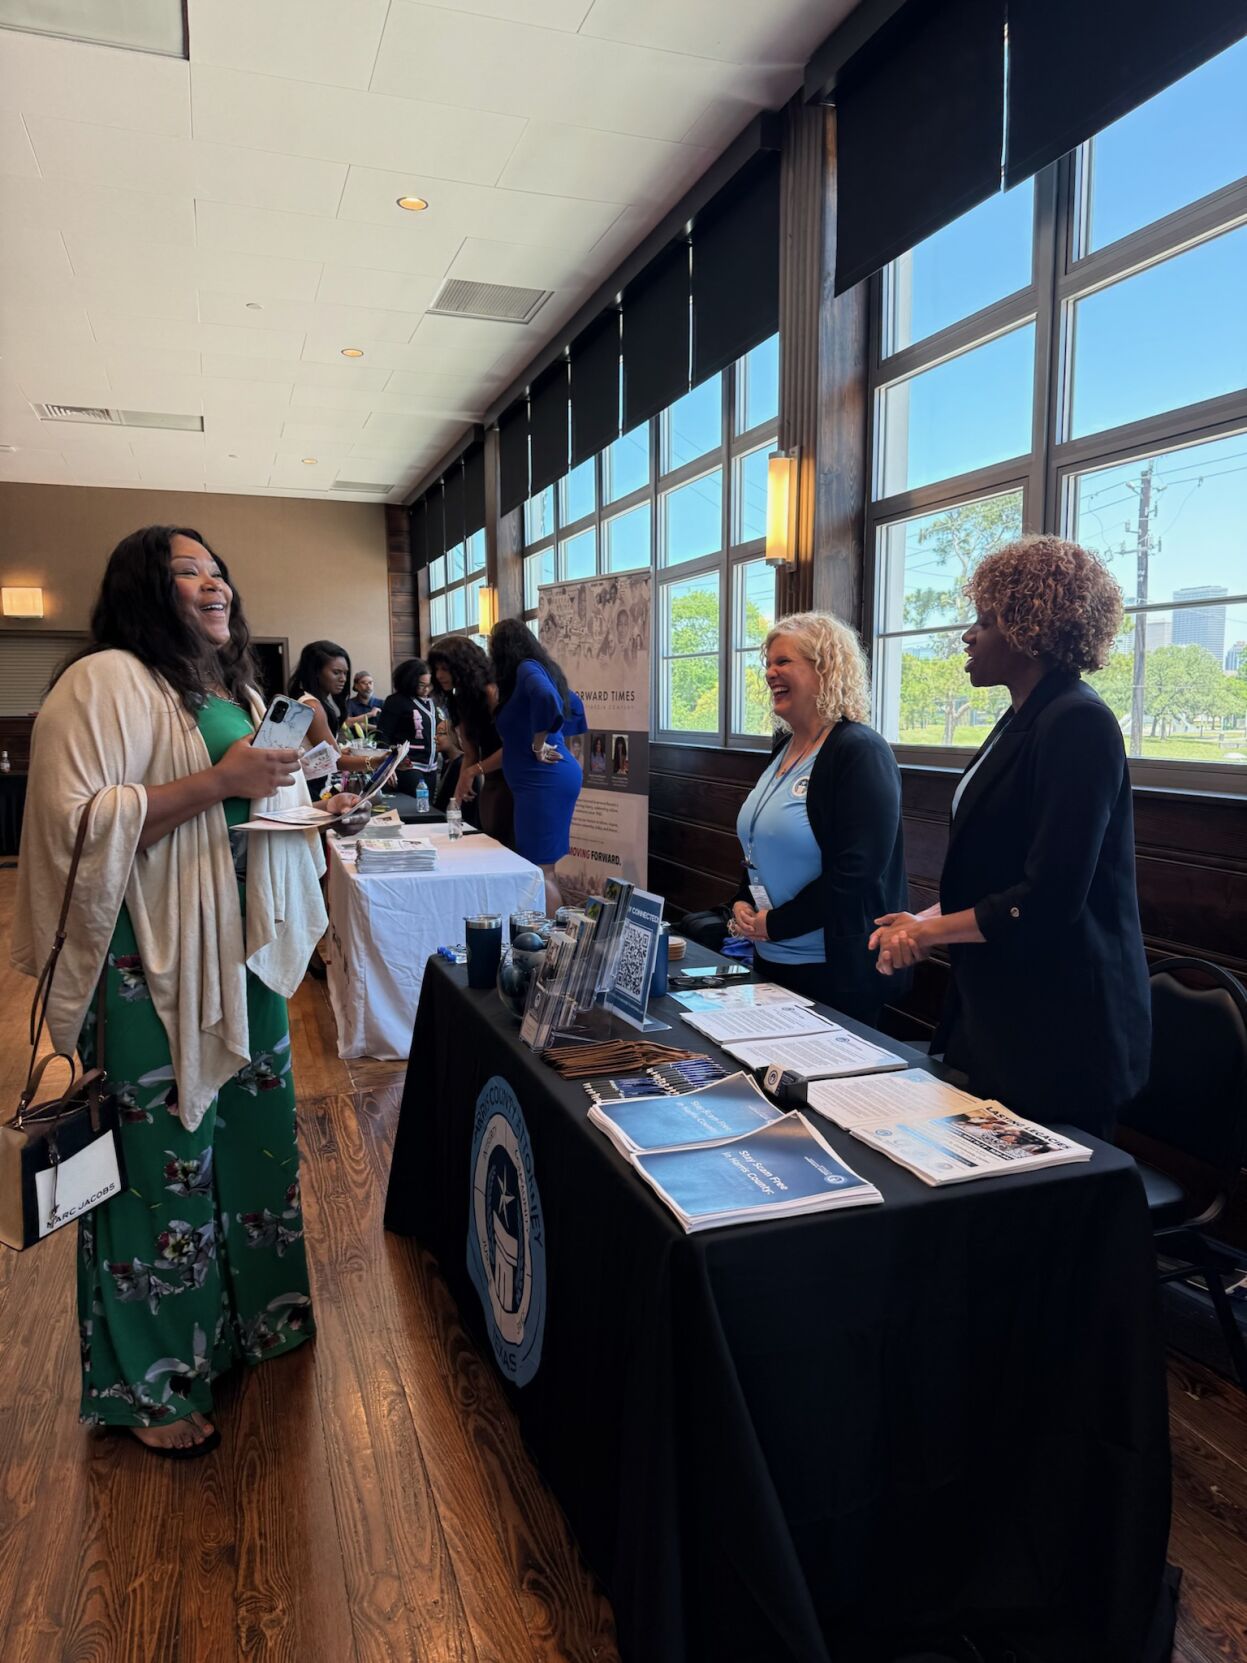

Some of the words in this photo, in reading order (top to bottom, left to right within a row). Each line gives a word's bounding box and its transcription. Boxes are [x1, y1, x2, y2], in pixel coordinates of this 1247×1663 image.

[575, 690, 608, 702] ORWARD
[611, 690, 635, 702] TIMES
[568, 846, 590, 860] MOVING
[591, 850, 622, 866] FORWARD.
[986, 1106, 1026, 1128] LASTING
[1025, 1125, 1072, 1150] LEGACIES
[730, 1157, 750, 1174] Harris
[739, 1150, 756, 1164] Stay
[752, 1162, 773, 1178] Scam
[46, 1207, 77, 1229] MARC
[78, 1182, 116, 1211] JACOBS
